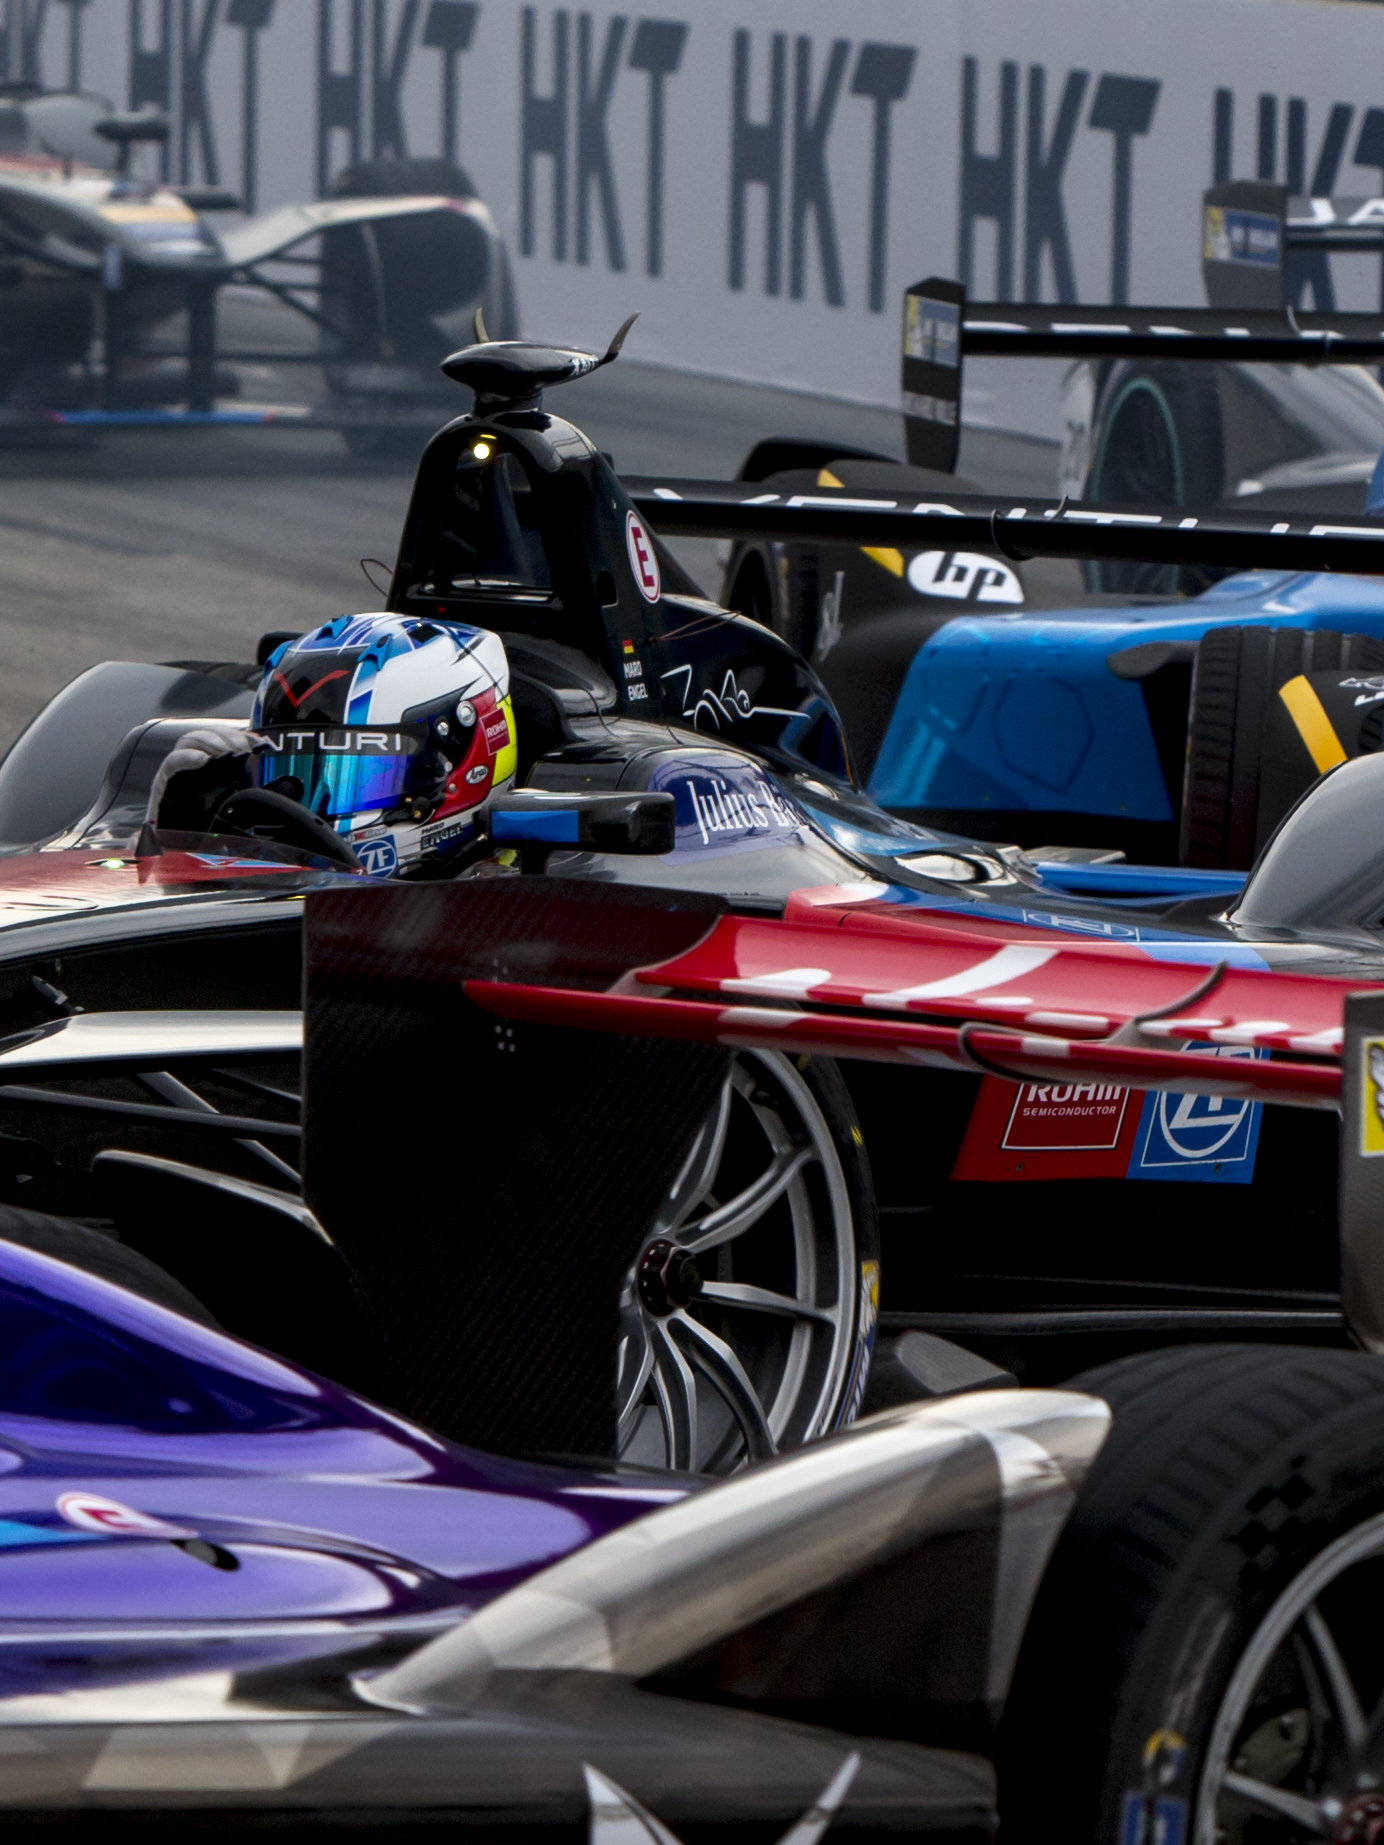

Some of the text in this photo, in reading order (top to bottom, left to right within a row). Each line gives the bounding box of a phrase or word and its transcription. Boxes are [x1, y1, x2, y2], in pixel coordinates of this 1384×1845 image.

[316, 0, 482, 200] HKT
[516, 4, 690, 279] HKT
[727, 27, 919, 314] HKT
[957, 54, 1163, 304] HKT
[931, 552, 1007, 600] hp
[421, 822, 464, 849] ENGEL
[686, 780, 770, 845] Julius
[359, 845, 396, 875] ZF
[1022, 1105, 1117, 1117] SEMICONDUCTOR
